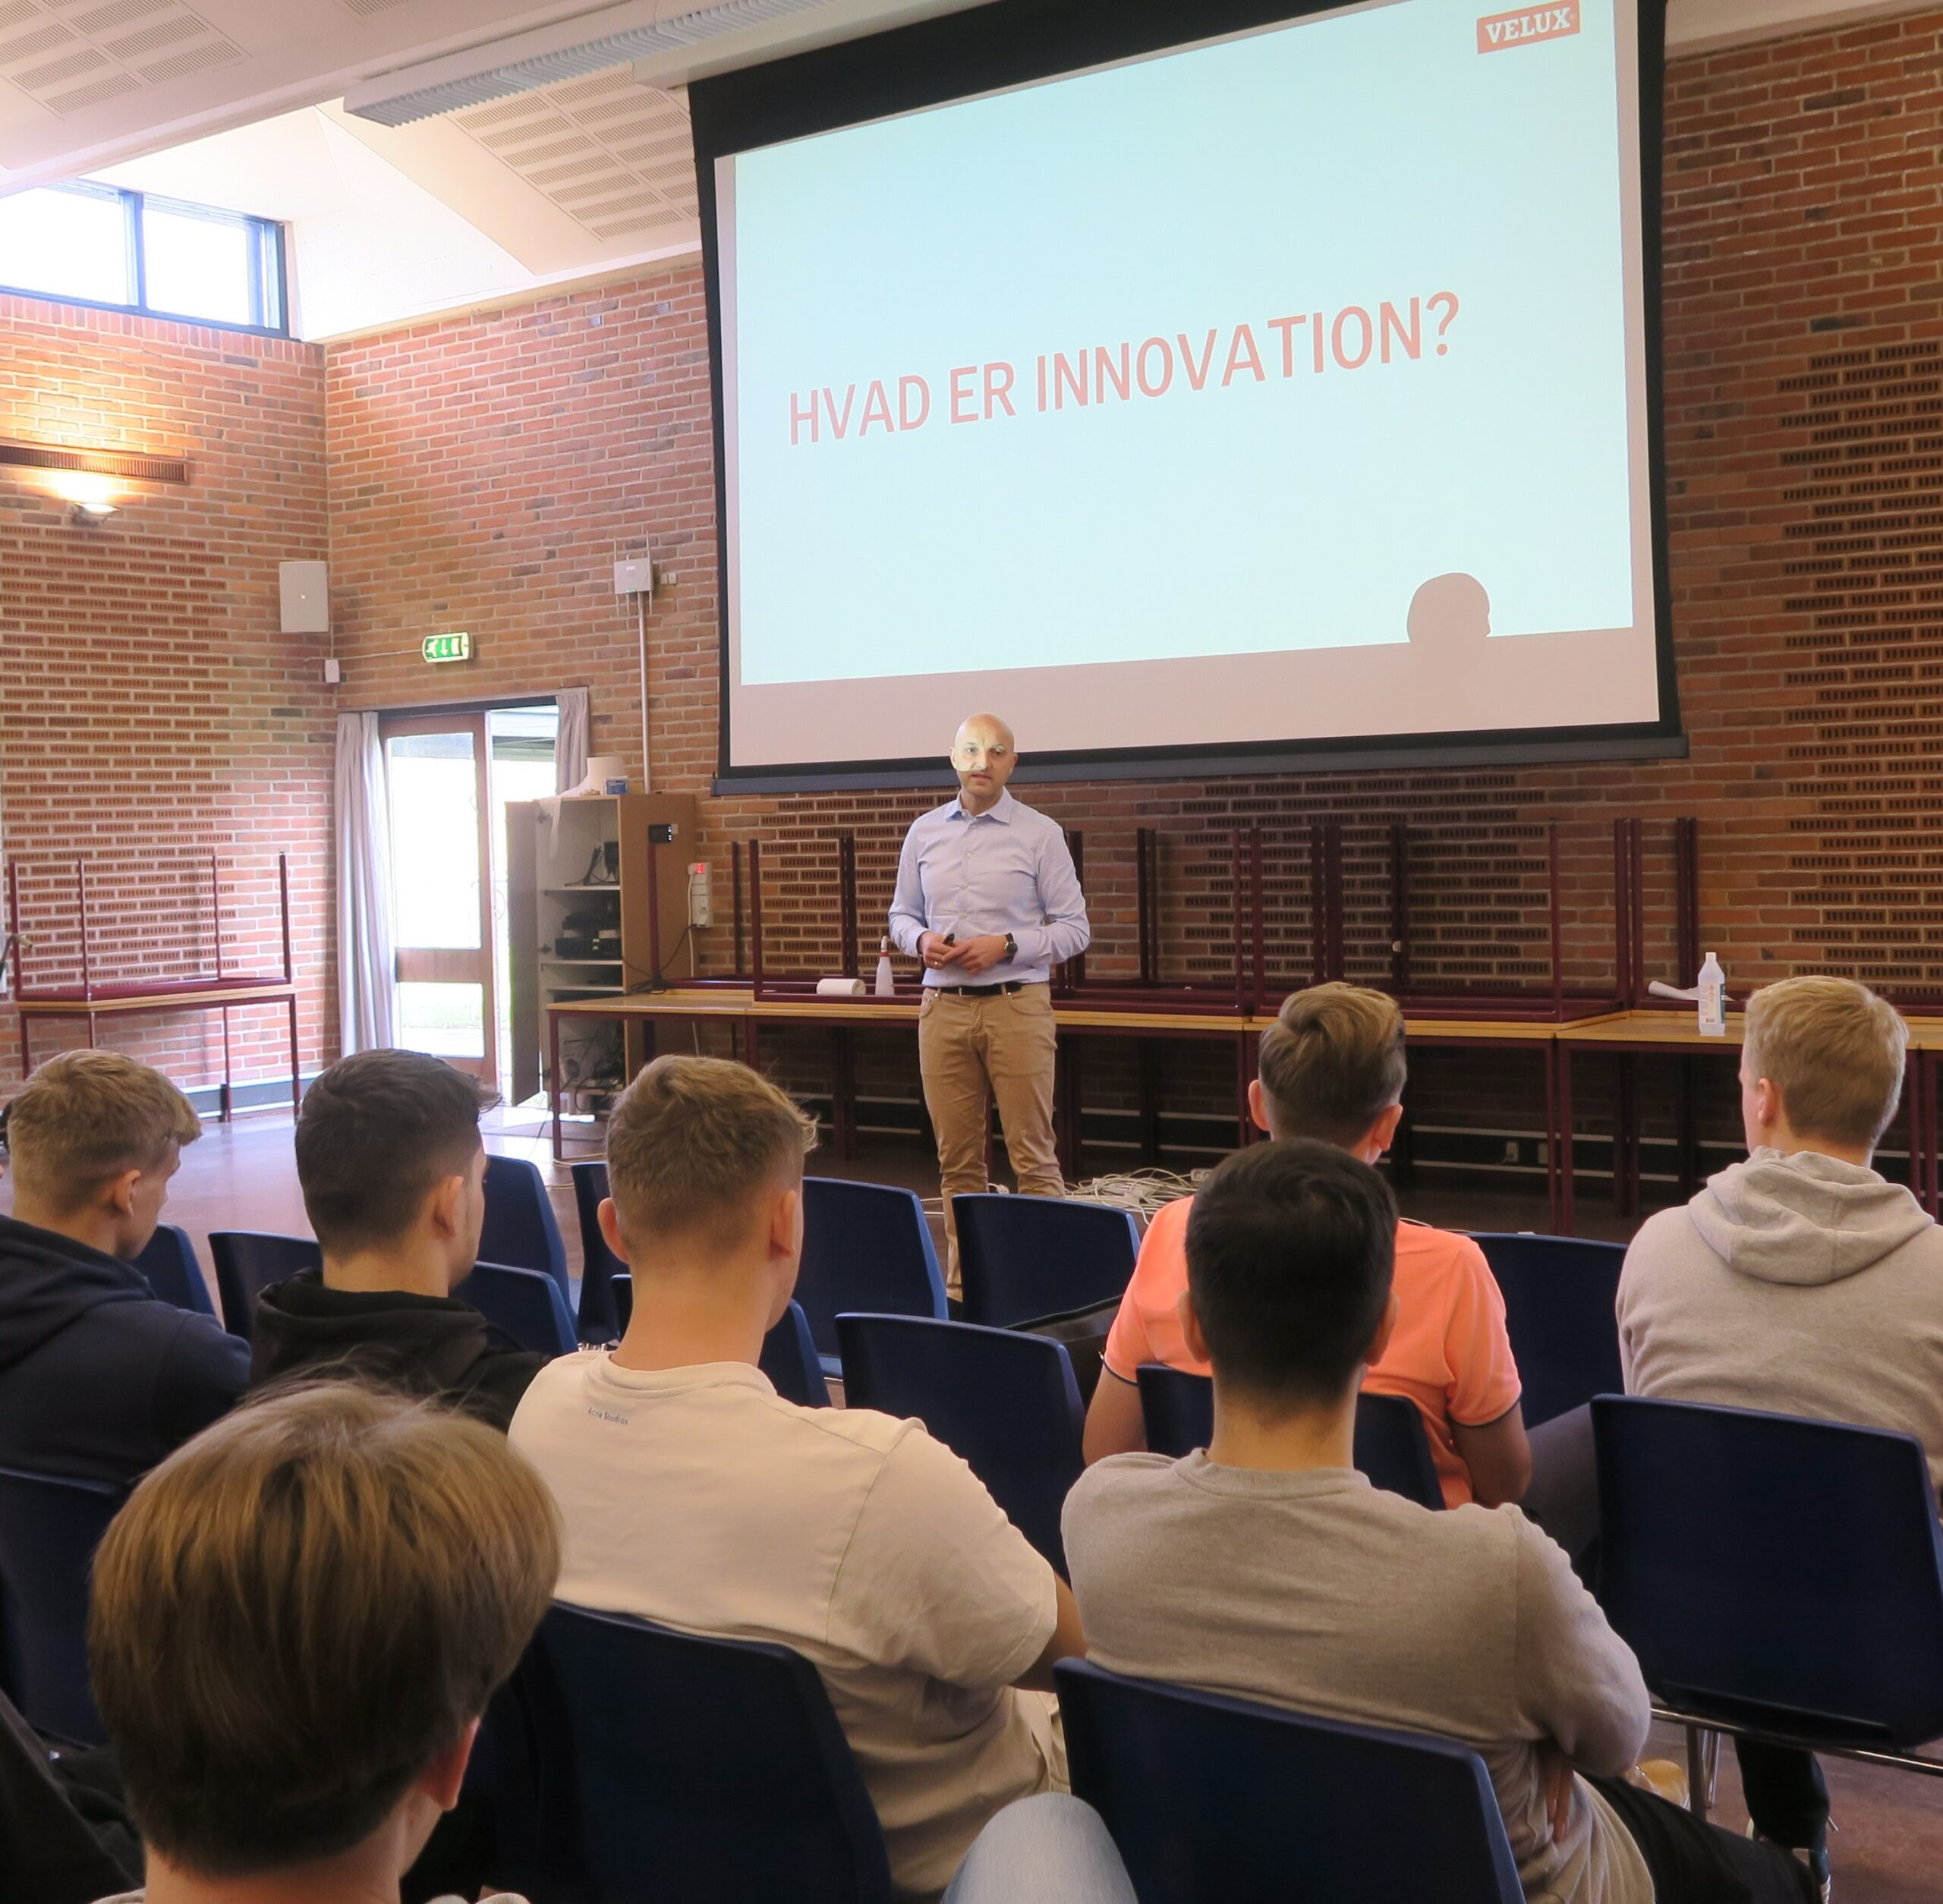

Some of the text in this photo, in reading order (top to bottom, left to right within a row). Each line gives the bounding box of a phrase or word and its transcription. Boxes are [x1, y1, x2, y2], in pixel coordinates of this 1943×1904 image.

[1485, 7, 1570, 44] VELUX
[790, 291, 1460, 445] HVAD ER INNOVATION?
